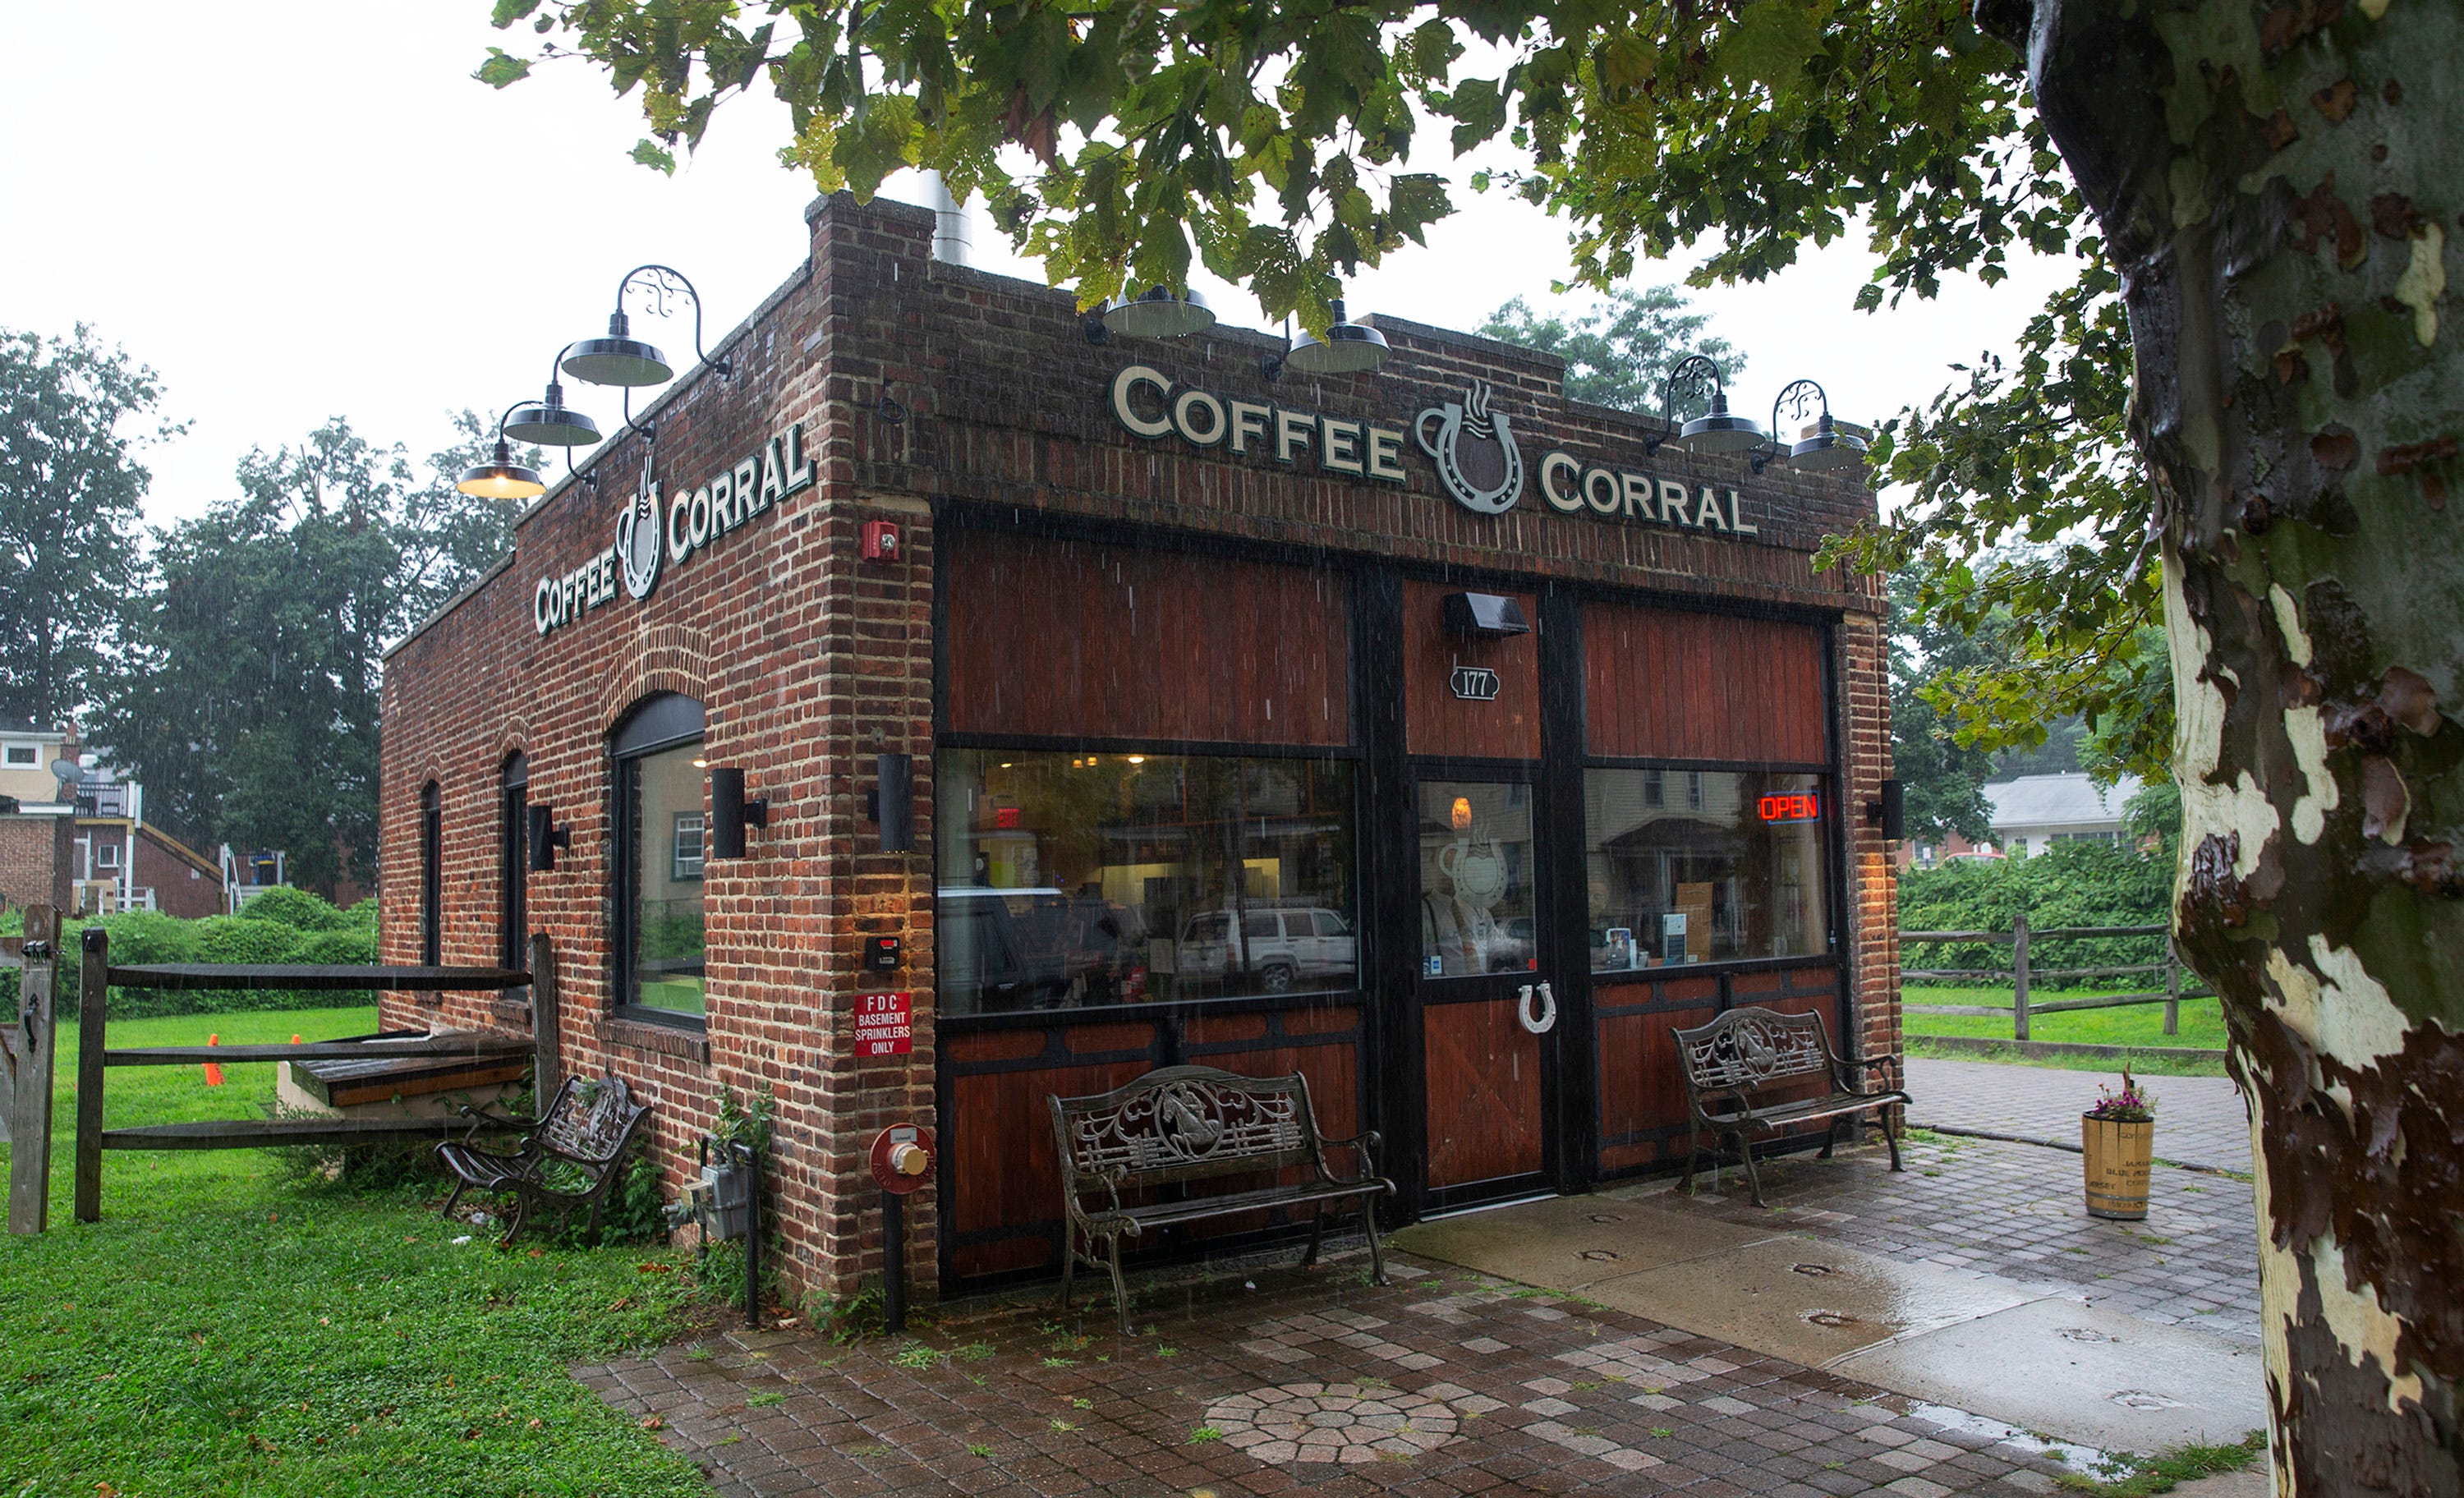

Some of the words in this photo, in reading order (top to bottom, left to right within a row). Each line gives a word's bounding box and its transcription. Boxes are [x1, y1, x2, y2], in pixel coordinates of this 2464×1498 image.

[1109, 364, 1407, 484] COFFEE
[1538, 450, 1759, 536] CORRAL
[535, 543, 618, 636] COFFEE
[669, 424, 816, 564] CORRAL
[1463, 670, 1488, 696] 177
[1760, 794, 1818, 820] OPEN
[858, 1012, 906, 1027] BASEMENT
[854, 1027, 911, 1041] SPRINKLERS
[871, 1041, 895, 1055] ONLY
[2106, 1168, 2129, 1177] BLUE
